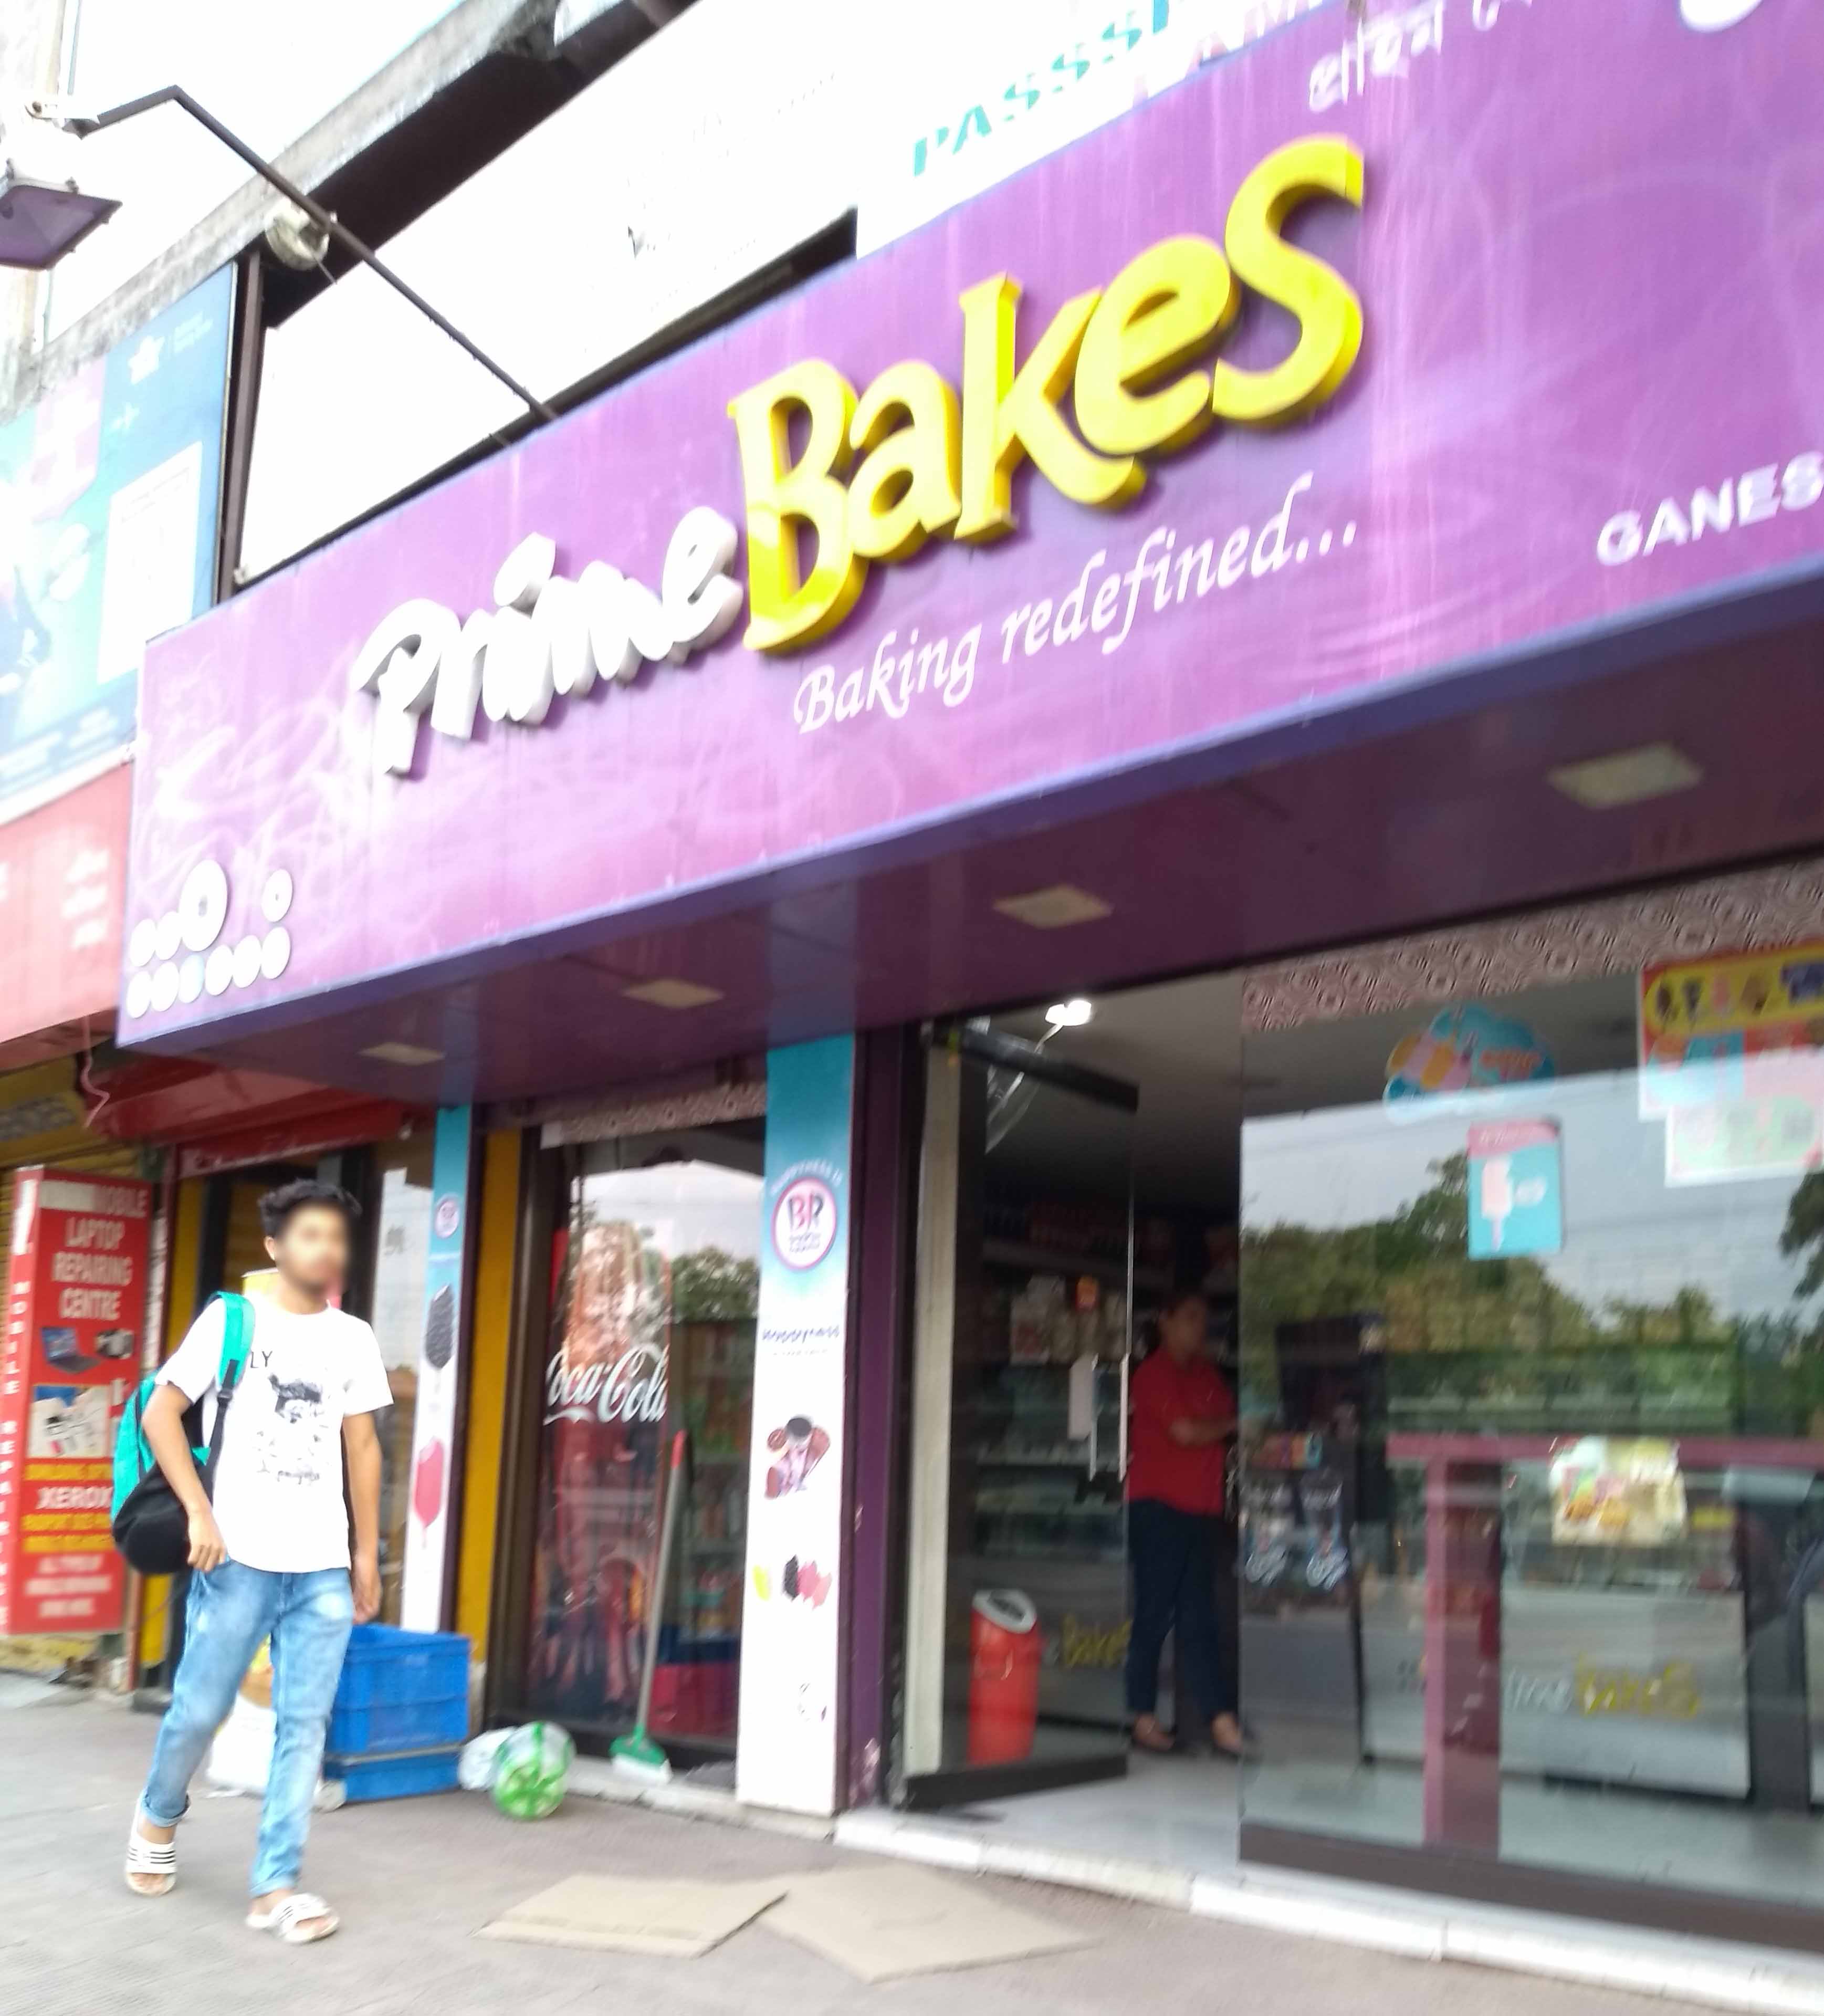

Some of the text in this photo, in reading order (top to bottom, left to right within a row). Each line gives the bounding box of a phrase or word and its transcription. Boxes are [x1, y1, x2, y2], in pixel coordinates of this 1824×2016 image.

[349, 506, 743, 775] Prime
[793, 623, 982, 734] Baking
[64, 1217, 125, 1250] LAPTOP
[59, 1287, 122, 1321] CENTRE
